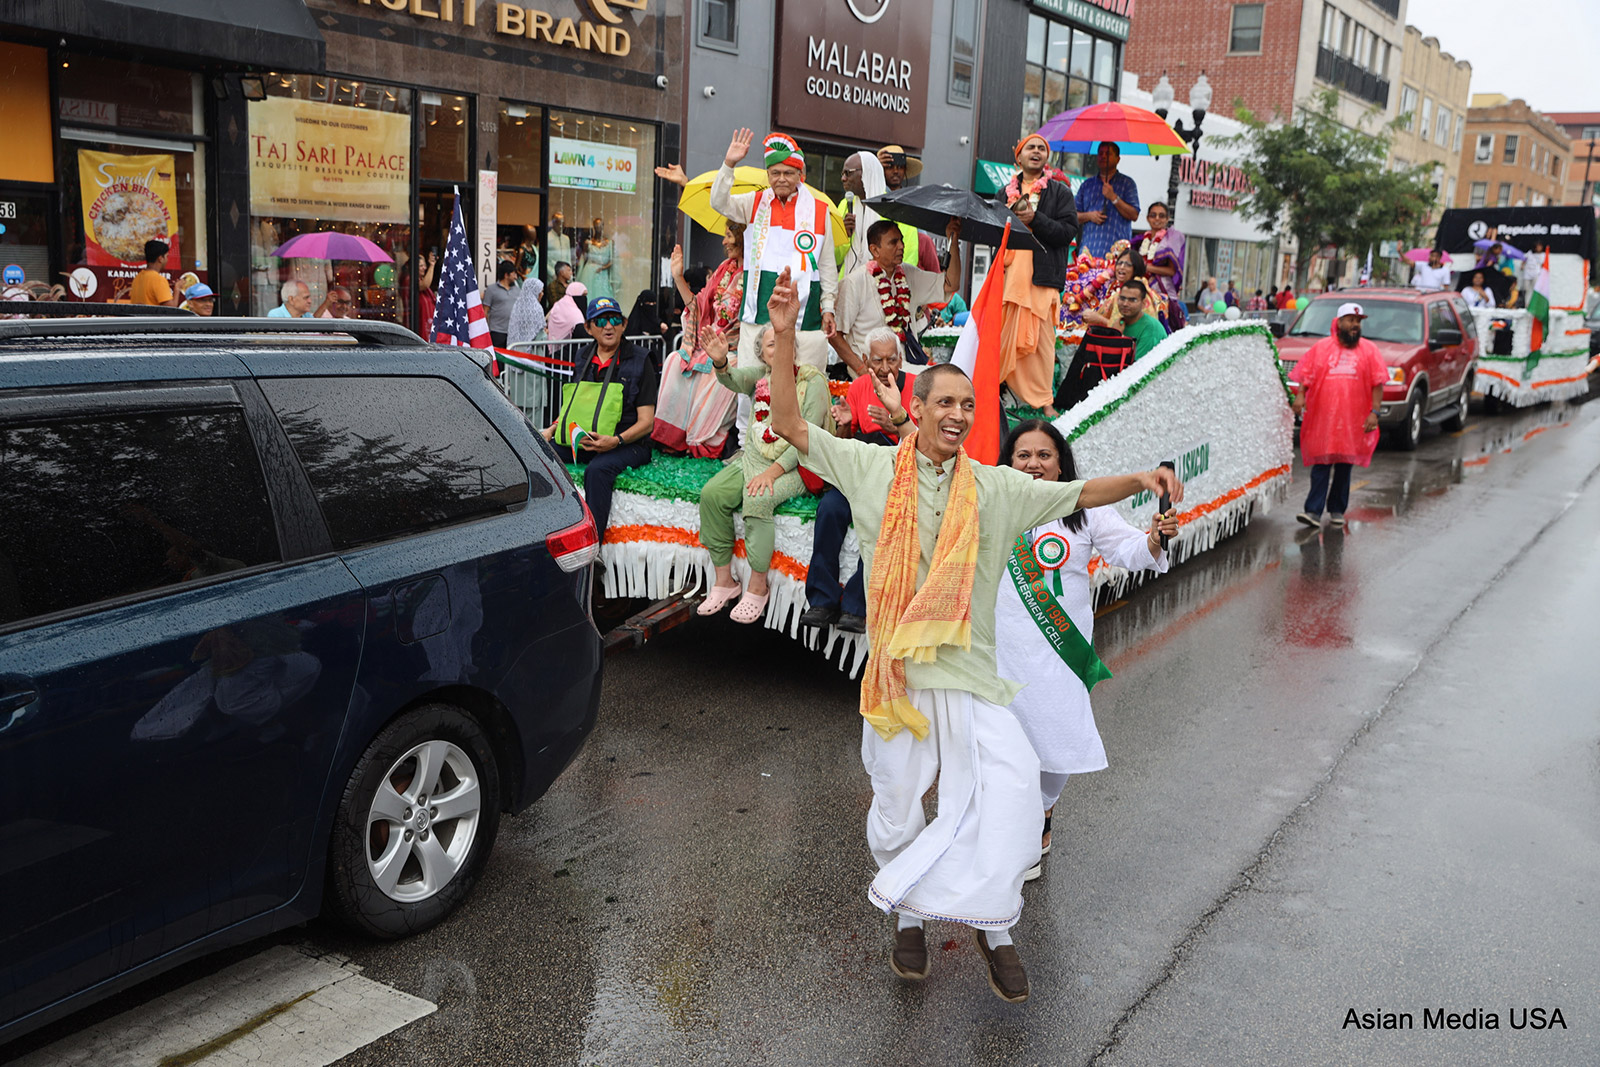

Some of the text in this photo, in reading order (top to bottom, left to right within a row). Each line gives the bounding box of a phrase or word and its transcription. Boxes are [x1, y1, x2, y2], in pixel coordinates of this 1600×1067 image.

[497, 3, 631, 57] BRAND
[1066, 0, 1088, 20] MEAT
[1088, 10, 1095, 24] &
[1095, 12, 1129, 37] GROCERY
[808, 35, 912, 91] MALABAR
[806, 76, 910, 115] GOLD & DIAMONDS
[295, 116, 320, 125] WELCOME
[341, 123, 369, 131] CUSTOMERS
[251, 135, 405, 171] TAJ SARI PALACE
[255, 160, 405, 181] EXQUISITE DESIGNER COUTURE
[554, 151, 587, 167] LAWN
[587, 155, 596, 168] 4
[95, 162, 156, 188] Special
[88, 183, 171, 222] CHICKEN BIRYANI
[1497, 223, 1582, 236] Republic Bank
[482, 242, 492, 292] SAL
[1007, 550, 1065, 650] MPOWERMENT CELL
[1014, 535, 1071, 633] CHICAGO 1980
